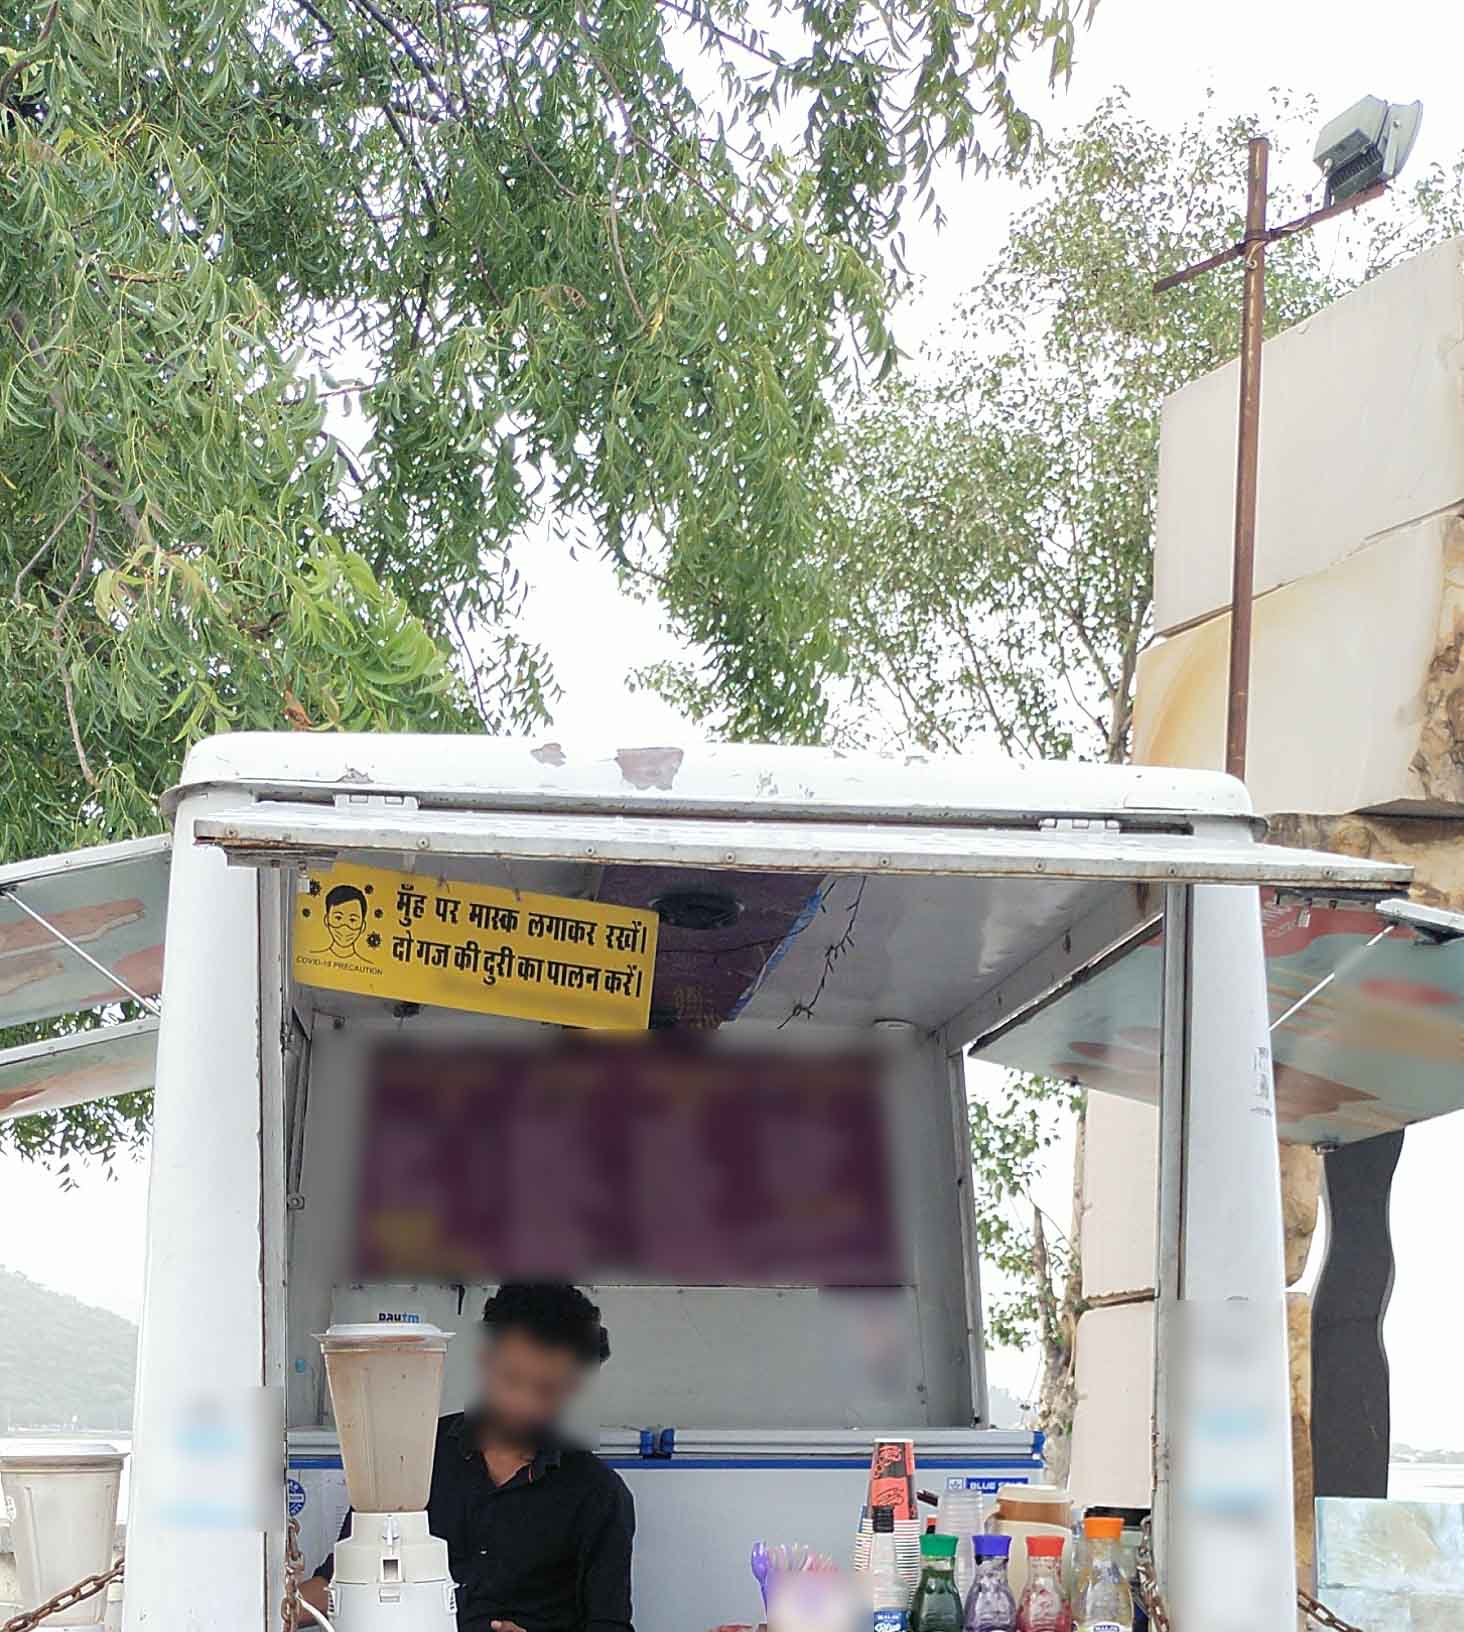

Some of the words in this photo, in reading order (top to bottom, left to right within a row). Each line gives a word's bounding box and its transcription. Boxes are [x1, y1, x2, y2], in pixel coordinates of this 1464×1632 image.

[435, 896, 462, 925] पर
[469, 902, 520, 933] मास्क
[528, 911, 598, 946] लगाकर
[295, 955, 332, 968] COVID-19
[333, 961, 384, 976] PRECAUTION
[392, 929, 414, 962] दो
[416, 940, 451, 969] गज
[454, 940, 480, 973] की
[517, 956, 545, 983] का
[547, 960, 602, 992] पालन
[969, 1481, 996, 1490] BLUE
